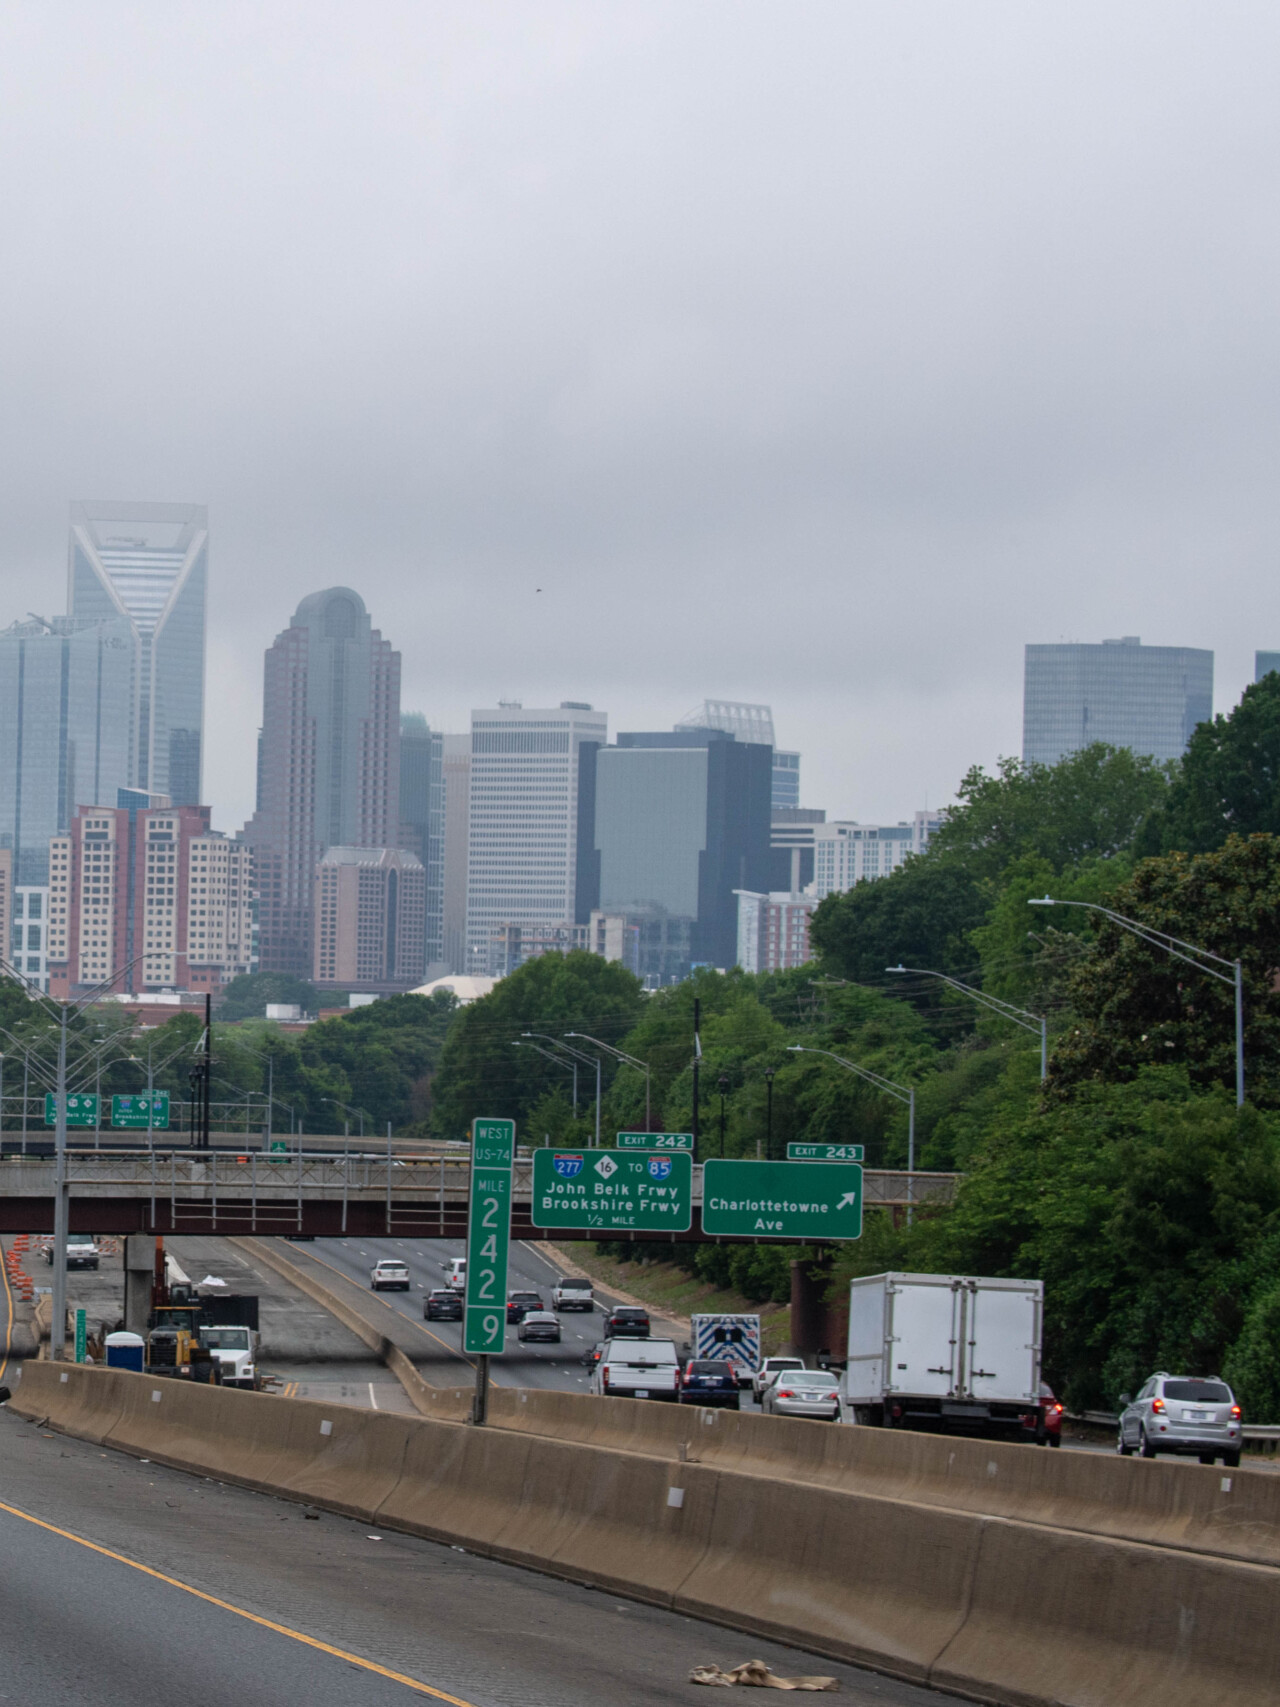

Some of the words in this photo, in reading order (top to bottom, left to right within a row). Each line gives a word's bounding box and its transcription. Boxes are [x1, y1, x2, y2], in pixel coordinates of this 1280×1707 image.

[479, 1127, 509, 1139] WEST
[625, 1136, 646, 1145] EXIT
[655, 1136, 687, 1147] 242
[475, 1148, 510, 1160] US-74
[795, 1147, 817, 1156] EXIT
[826, 1147, 856, 1159] 243
[558, 1161, 580, 1173] 277
[600, 1161, 612, 1173] 16
[628, 1163, 643, 1173] TO
[649, 1162, 670, 1176] 85
[478, 1180, 505, 1192] MILE
[546, 1182, 585, 1194] John
[594, 1183, 629, 1196] Belk
[638, 1184, 678, 1199] Frwy
[542, 1197, 634, 1211] Brookshire
[640, 1200, 680, 1215] Frwy
[709, 1198, 829, 1213] Charlottetowne
[611, 1216, 635, 1225] MILE
[754, 1218, 784, 1230] Ave
